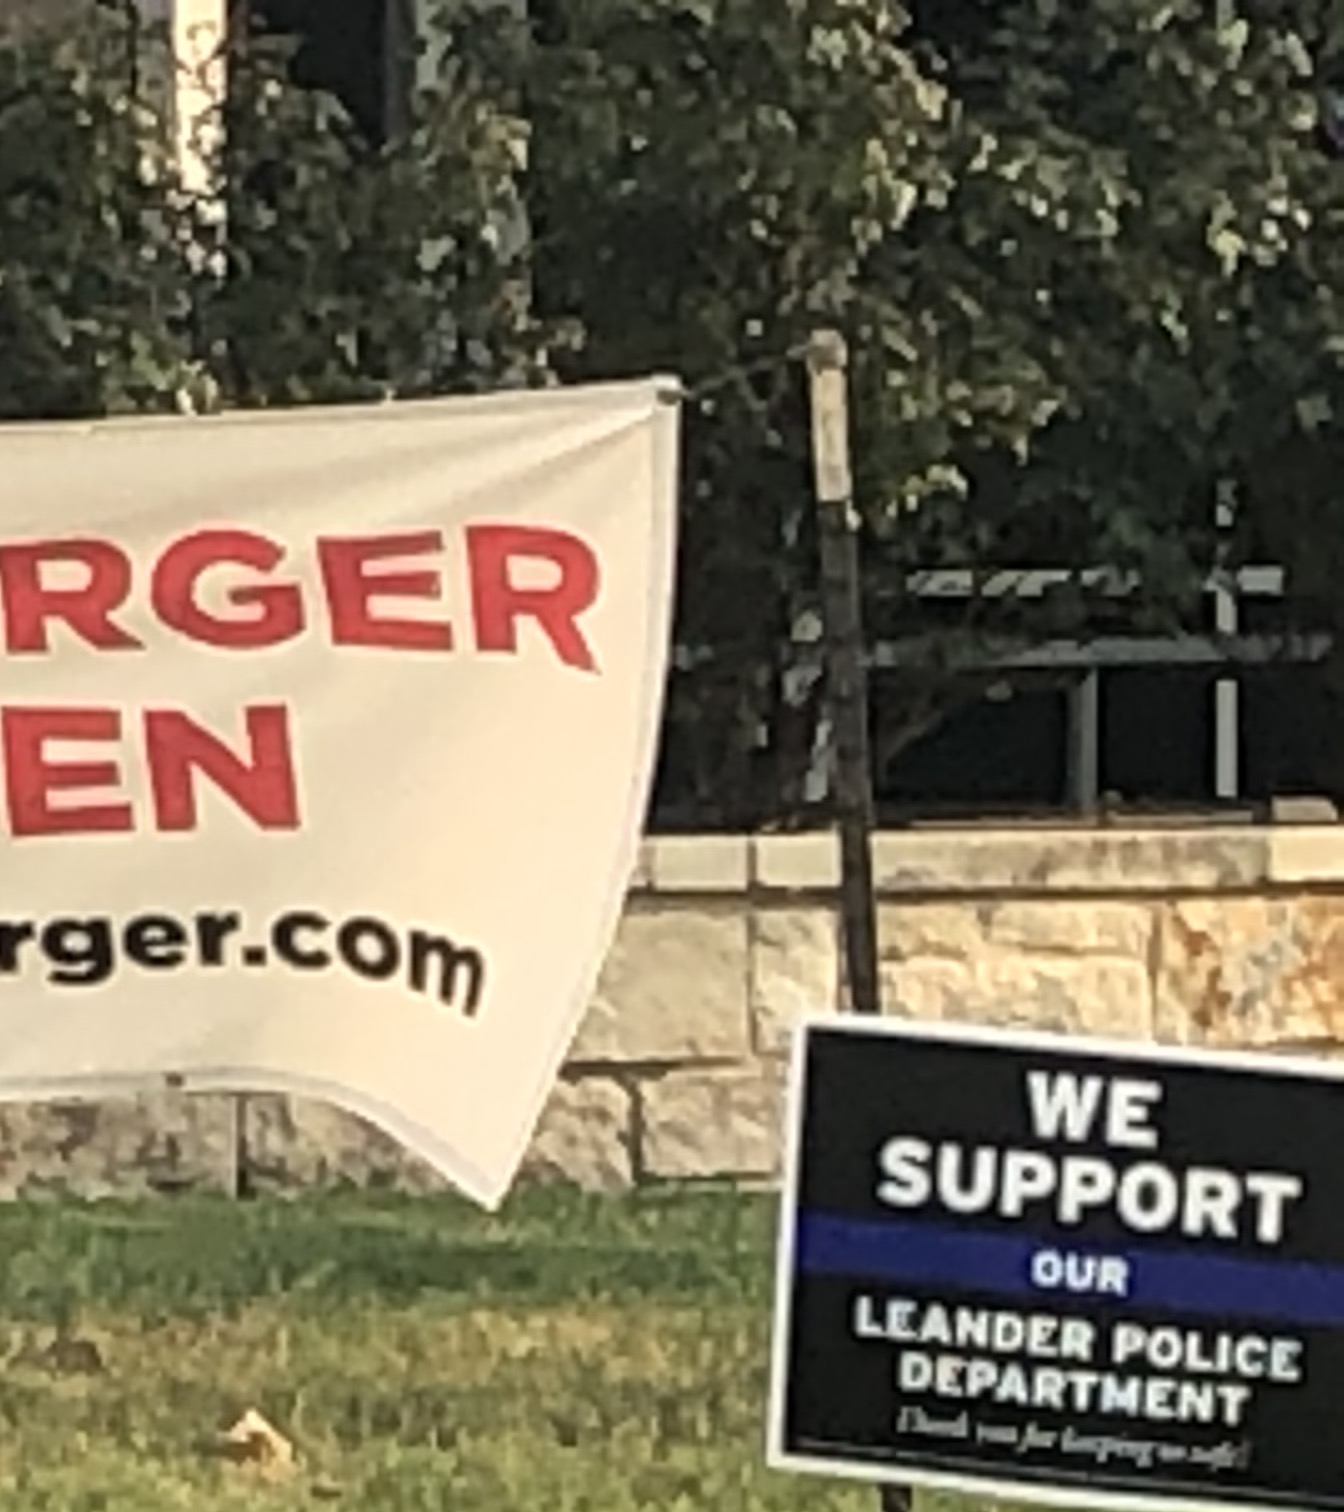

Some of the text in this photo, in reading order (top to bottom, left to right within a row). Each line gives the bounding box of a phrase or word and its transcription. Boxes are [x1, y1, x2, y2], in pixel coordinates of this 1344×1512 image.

[1026, 1069, 1162, 1148] WE
[876, 1136, 1303, 1242] SUPPORT
[1030, 1248, 1130, 1294] OUR
[853, 1296, 1303, 1380] LEANDER POLICE
[897, 1350, 1251, 1426] DEPARTMENT
